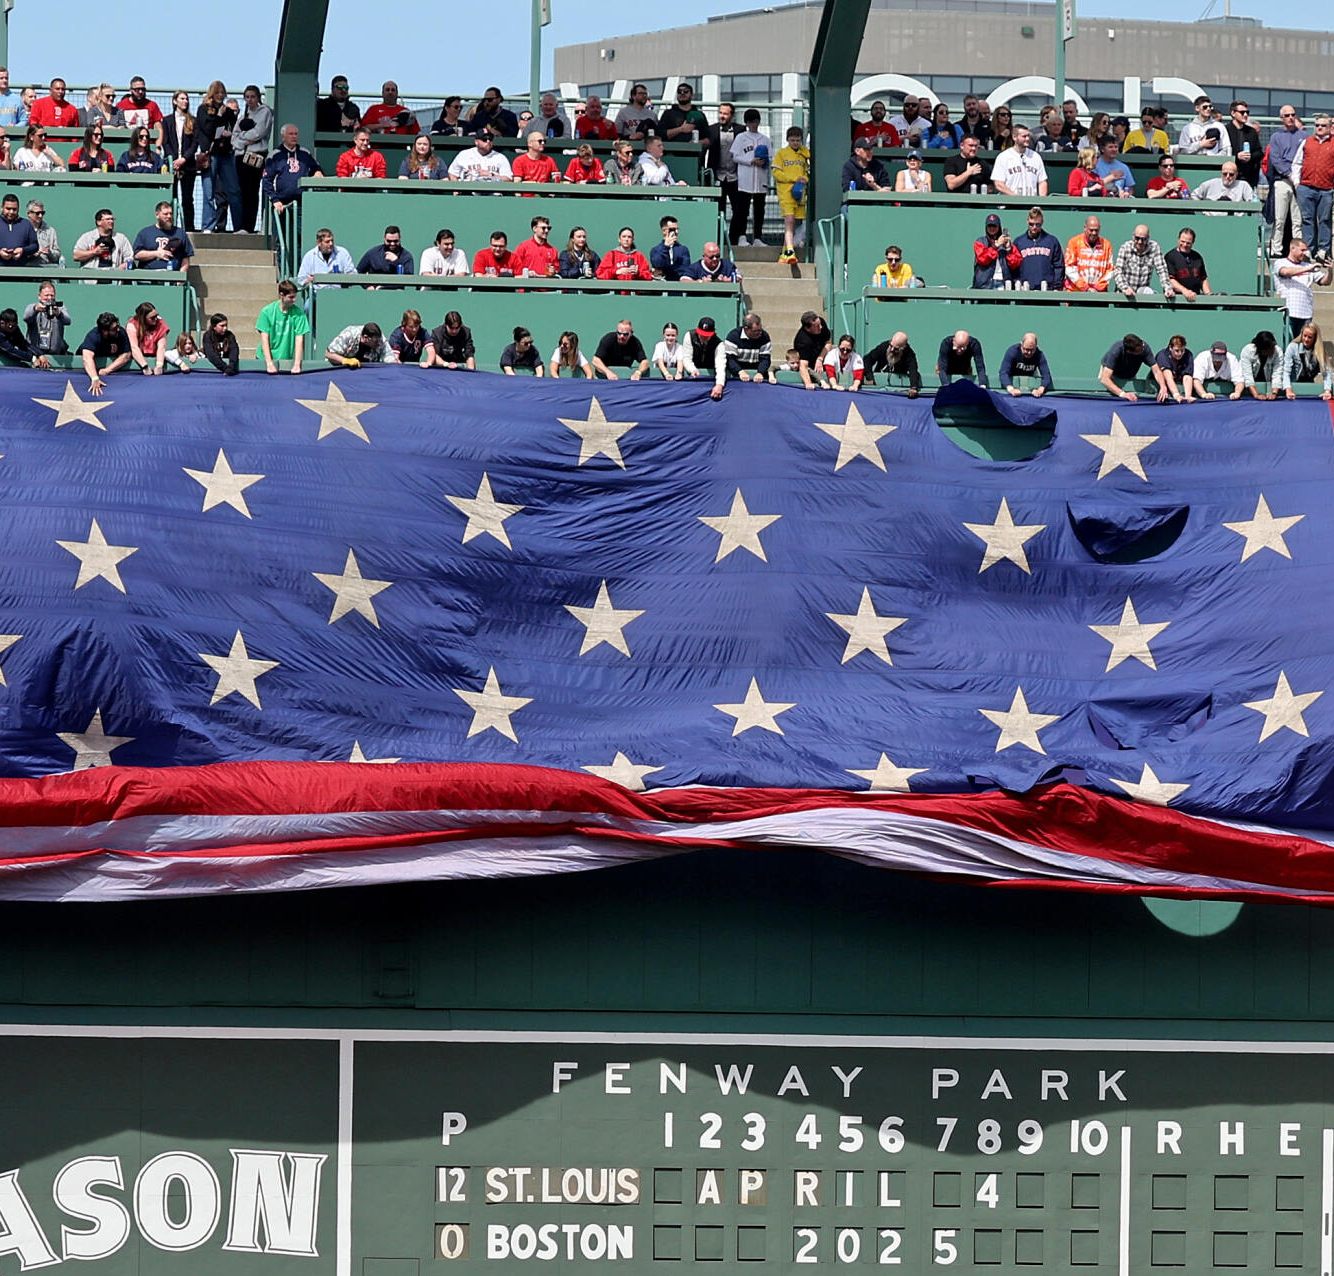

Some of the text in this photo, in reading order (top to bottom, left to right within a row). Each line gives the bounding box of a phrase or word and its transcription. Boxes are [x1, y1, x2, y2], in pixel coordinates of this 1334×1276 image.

[553, 1062, 1128, 1100] FENWAY PARK
[442, 1112, 1300, 1156] P 1 2 3 4 5 6 7 8 9 10 R H E
[439, 1167, 466, 1202] 12
[977, 1174, 998, 1208] 4
[441, 1224, 464, 1259] 0
[488, 1224, 633, 1260] BOSTON
